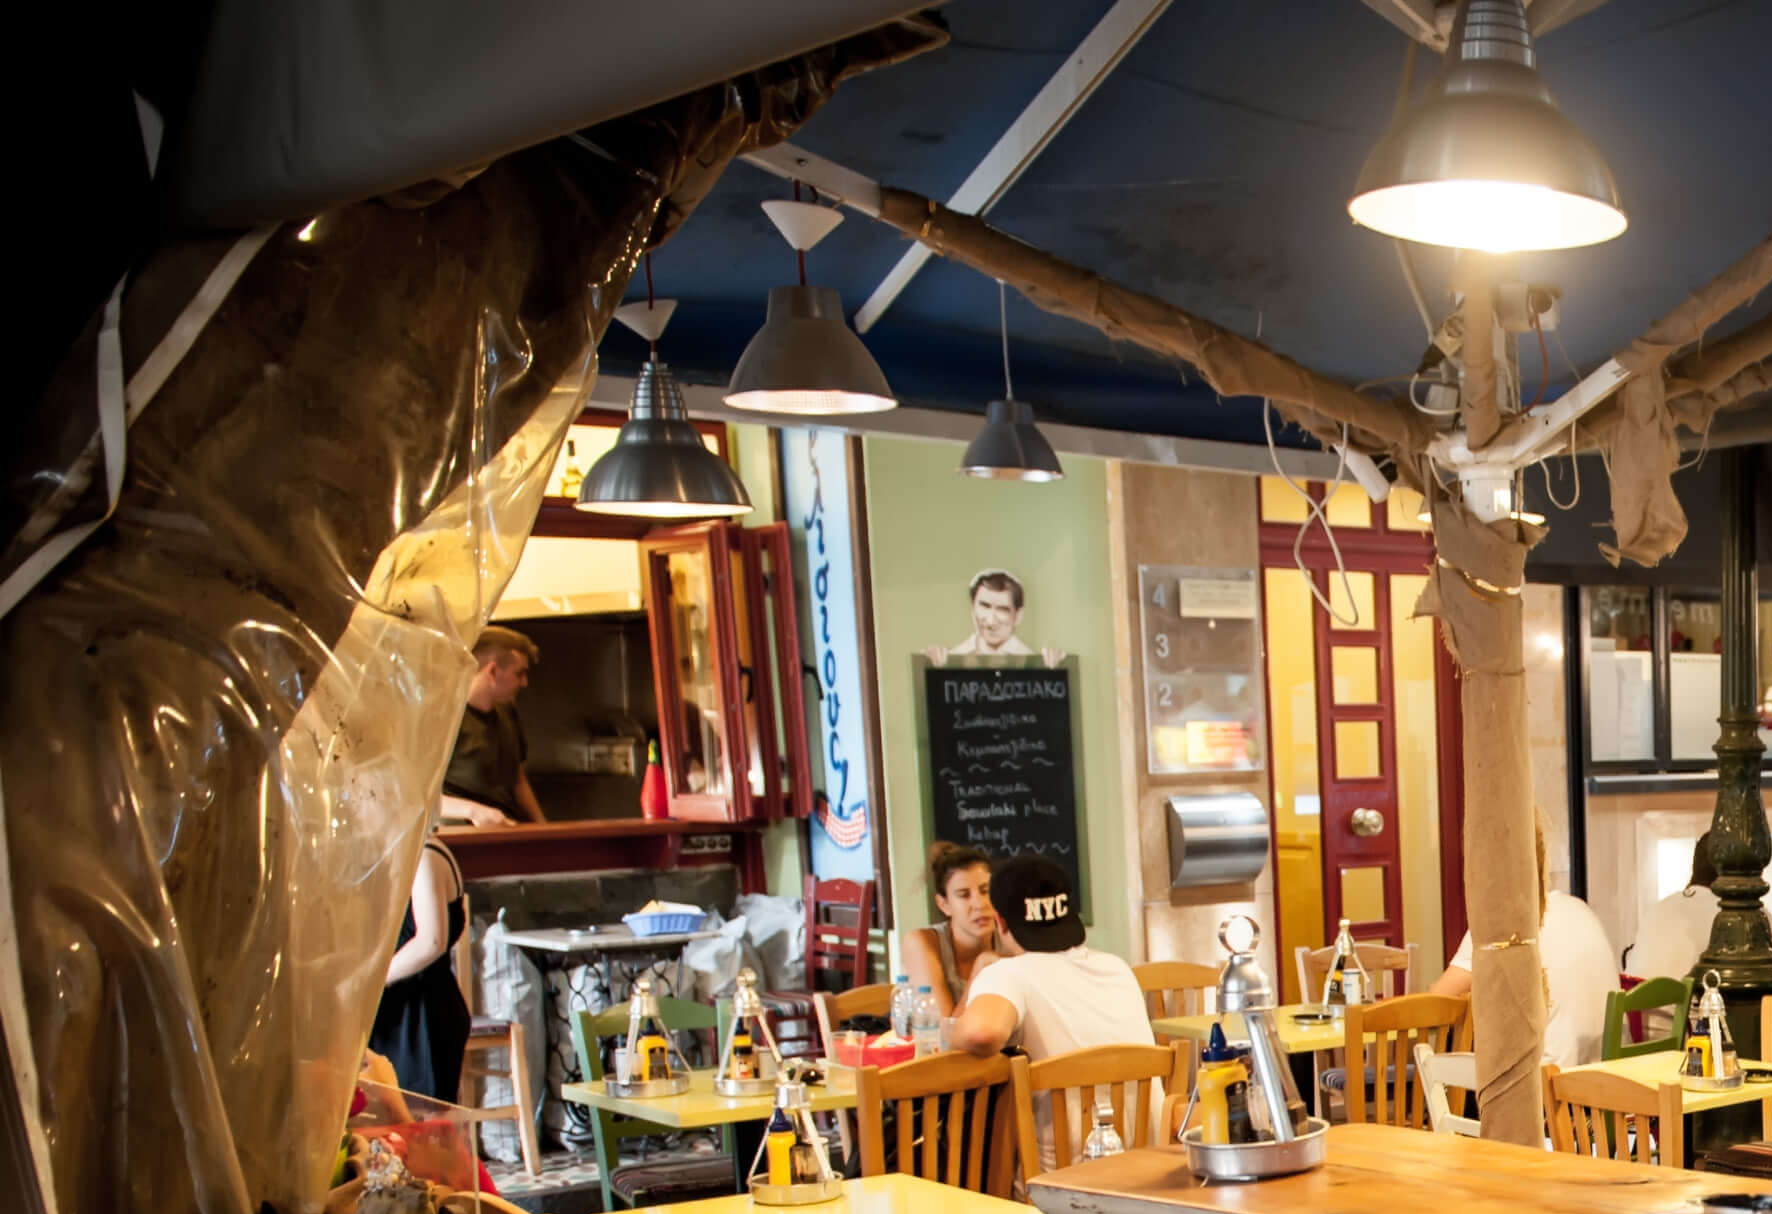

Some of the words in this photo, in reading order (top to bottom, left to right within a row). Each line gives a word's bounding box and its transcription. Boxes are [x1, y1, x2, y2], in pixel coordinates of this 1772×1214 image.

[1155, 633, 1170, 659] 3
[943, 679, 1067, 704] ΠΑΡΑΔΟΣΙΑΚΟ
[1159, 682, 1173, 708] 2
[1024, 893, 1068, 921] NYC
